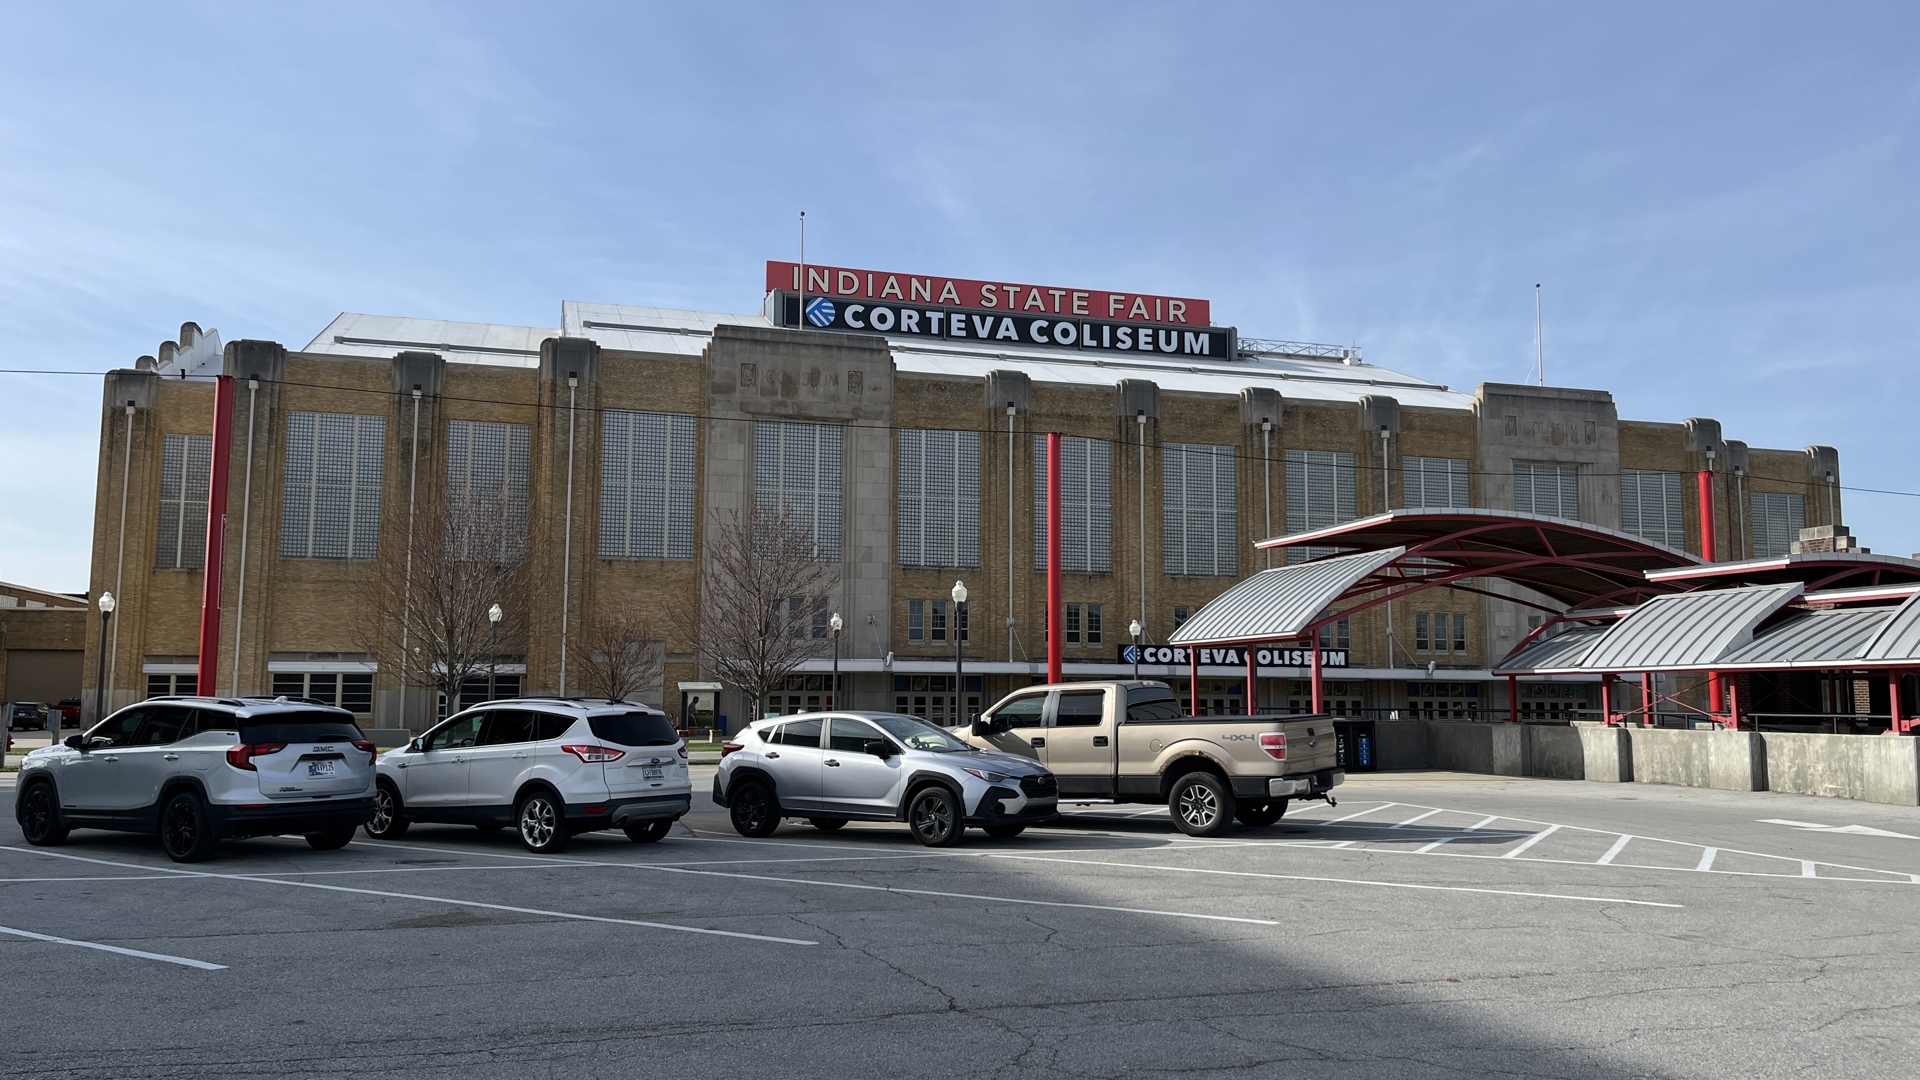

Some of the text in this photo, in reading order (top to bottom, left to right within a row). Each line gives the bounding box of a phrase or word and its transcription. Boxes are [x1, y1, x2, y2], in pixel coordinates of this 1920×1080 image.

[792, 265, 1188, 324] INDIANA STATE FAIR
[843, 303, 1211, 355] CORTEVA COLISEUM
[765, 369, 839, 388] COLISEUM
[1523, 420, 1579, 436] COLISEUM
[312, 745, 335, 753] GMC
